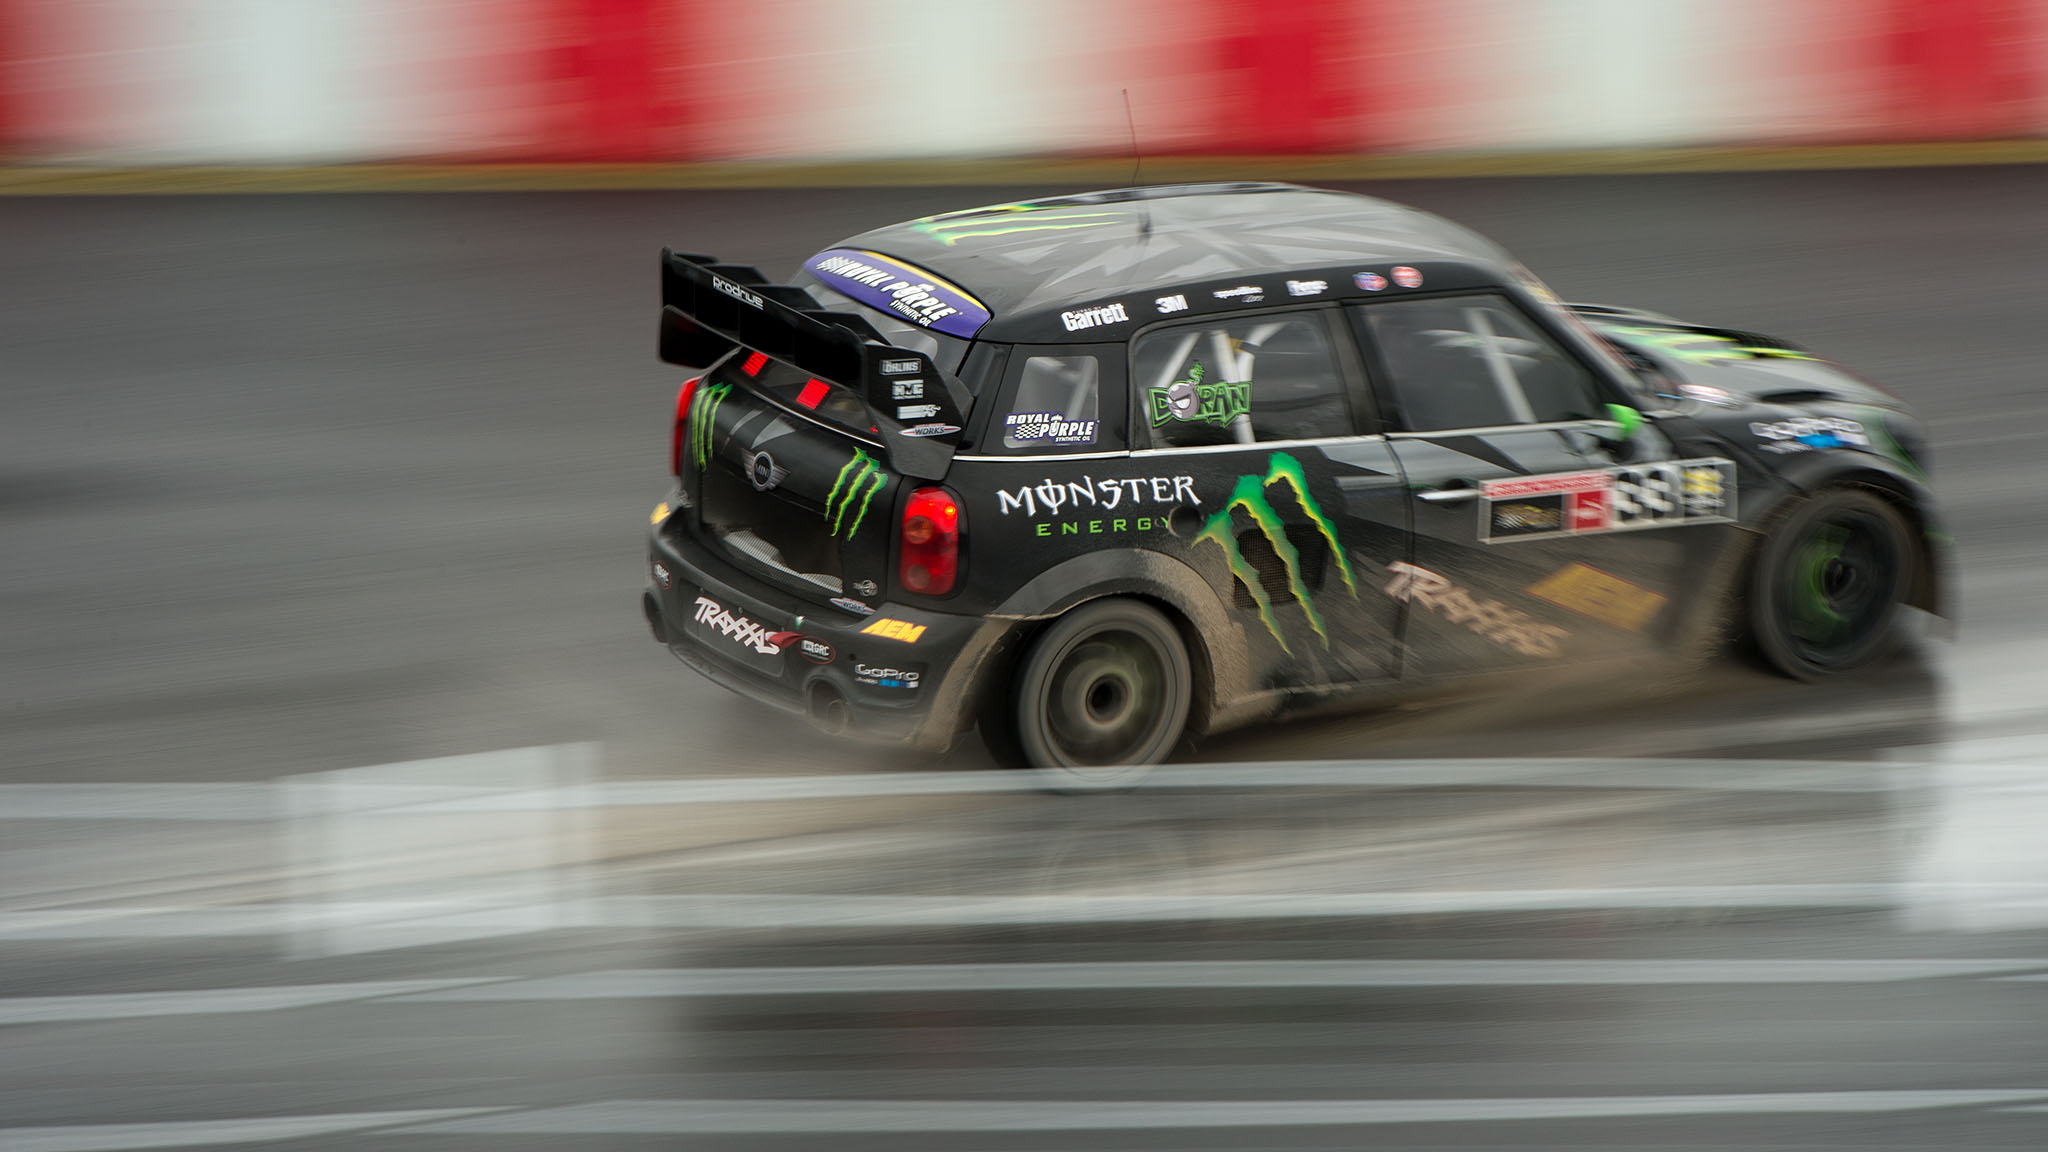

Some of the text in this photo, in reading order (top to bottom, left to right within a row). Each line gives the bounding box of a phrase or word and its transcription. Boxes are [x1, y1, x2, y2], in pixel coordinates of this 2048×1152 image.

[880, 281, 958, 321] PURPLE
[1154, 294, 1189, 314] 3M
[1061, 303, 1129, 332] Garrett
[1006, 413, 1050, 425] ROYAL
[914, 426, 945, 436] WORKS
[1038, 421, 1095, 438] PURPLE
[858, 618, 928, 644] AEM
[855, 664, 919, 681] GoPro
